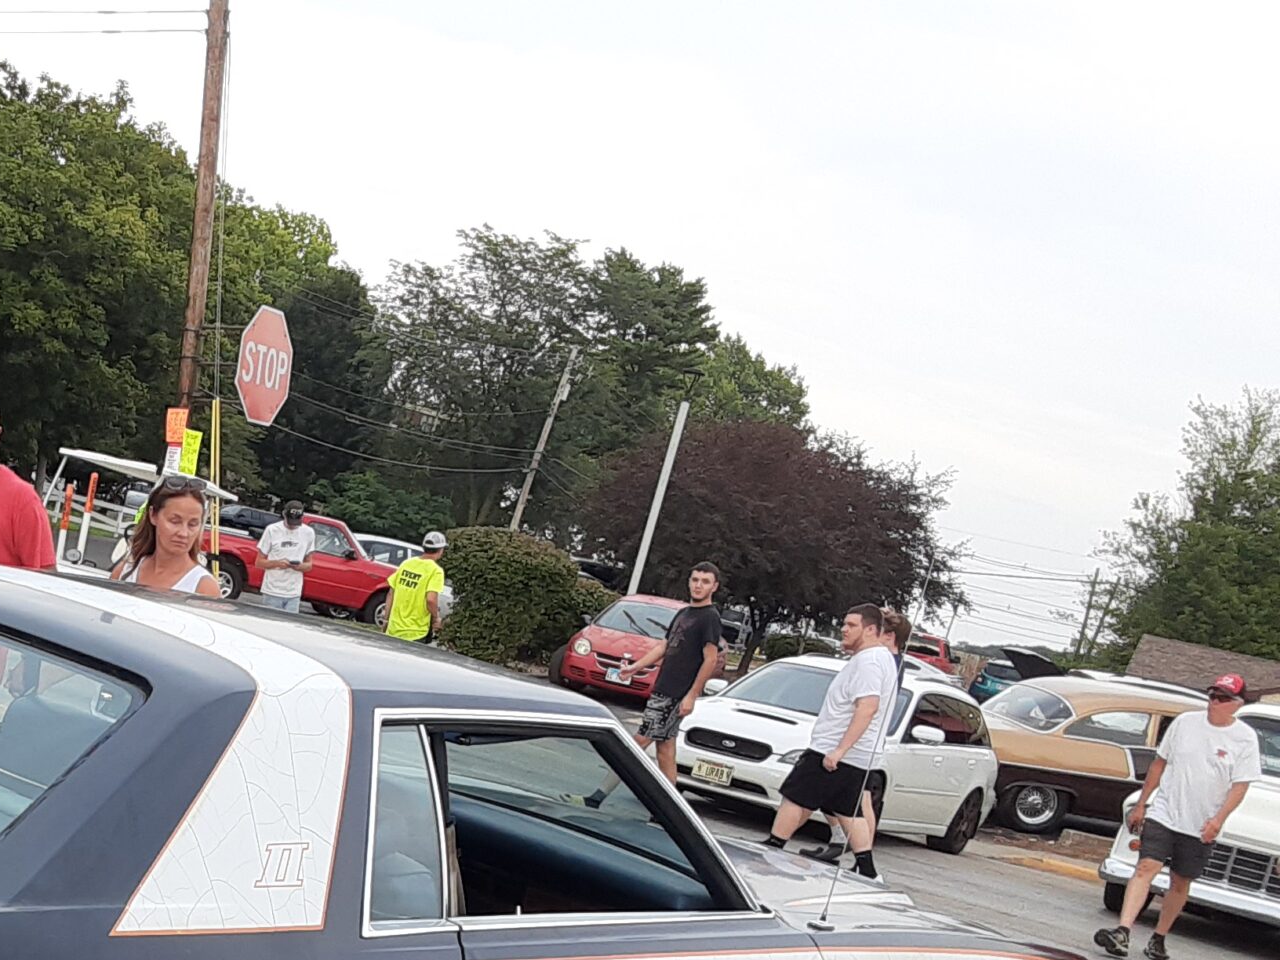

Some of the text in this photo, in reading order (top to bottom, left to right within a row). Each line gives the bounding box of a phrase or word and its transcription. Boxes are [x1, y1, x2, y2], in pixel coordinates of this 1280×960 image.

[242, 341, 288, 391] STOP
[401, 569, 422, 581] EVENT
[399, 577, 419, 589] STAFF
